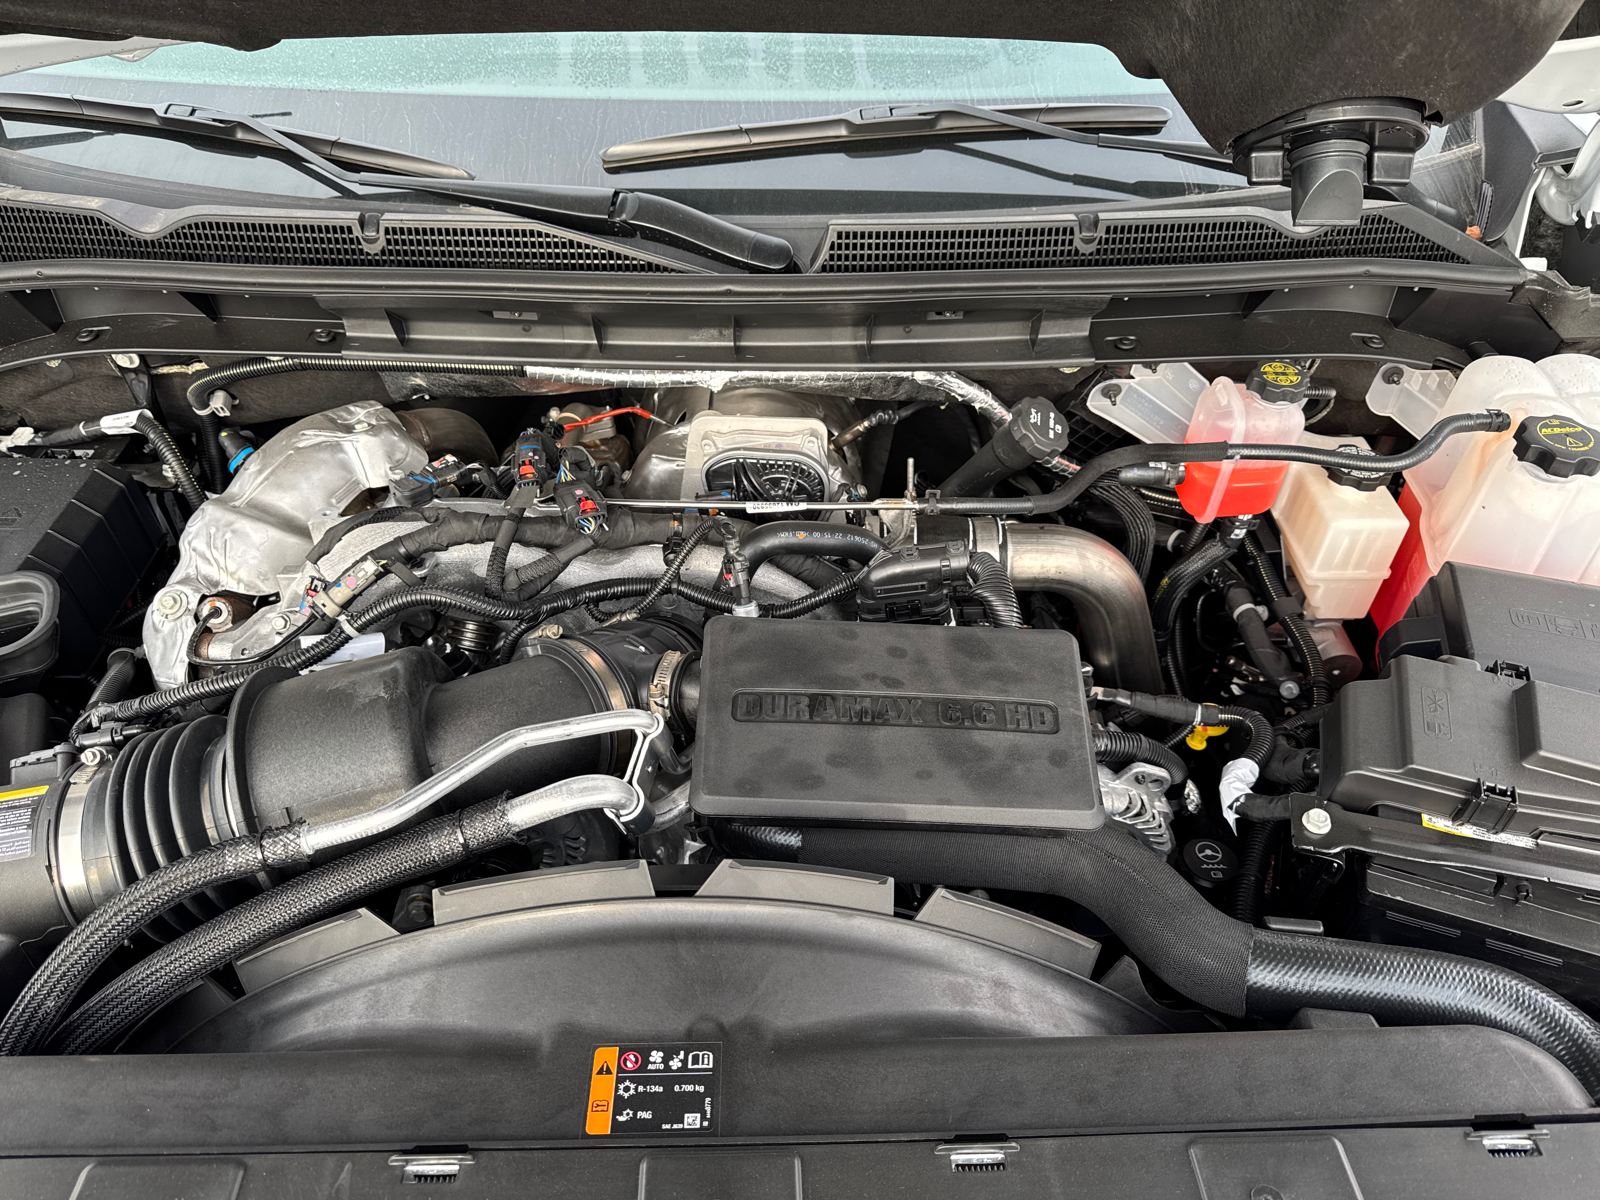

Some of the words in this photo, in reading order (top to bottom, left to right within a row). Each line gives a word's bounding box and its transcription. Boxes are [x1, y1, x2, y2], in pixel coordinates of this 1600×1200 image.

[736, 693, 923, 725] DURAMAX
[937, 699, 997, 726] 6.6
[1003, 702, 1058, 730] HD
[674, 1084, 695, 1092] 0.700
[695, 1084, 705, 1093] kg
[637, 1111, 652, 1119] PAG
